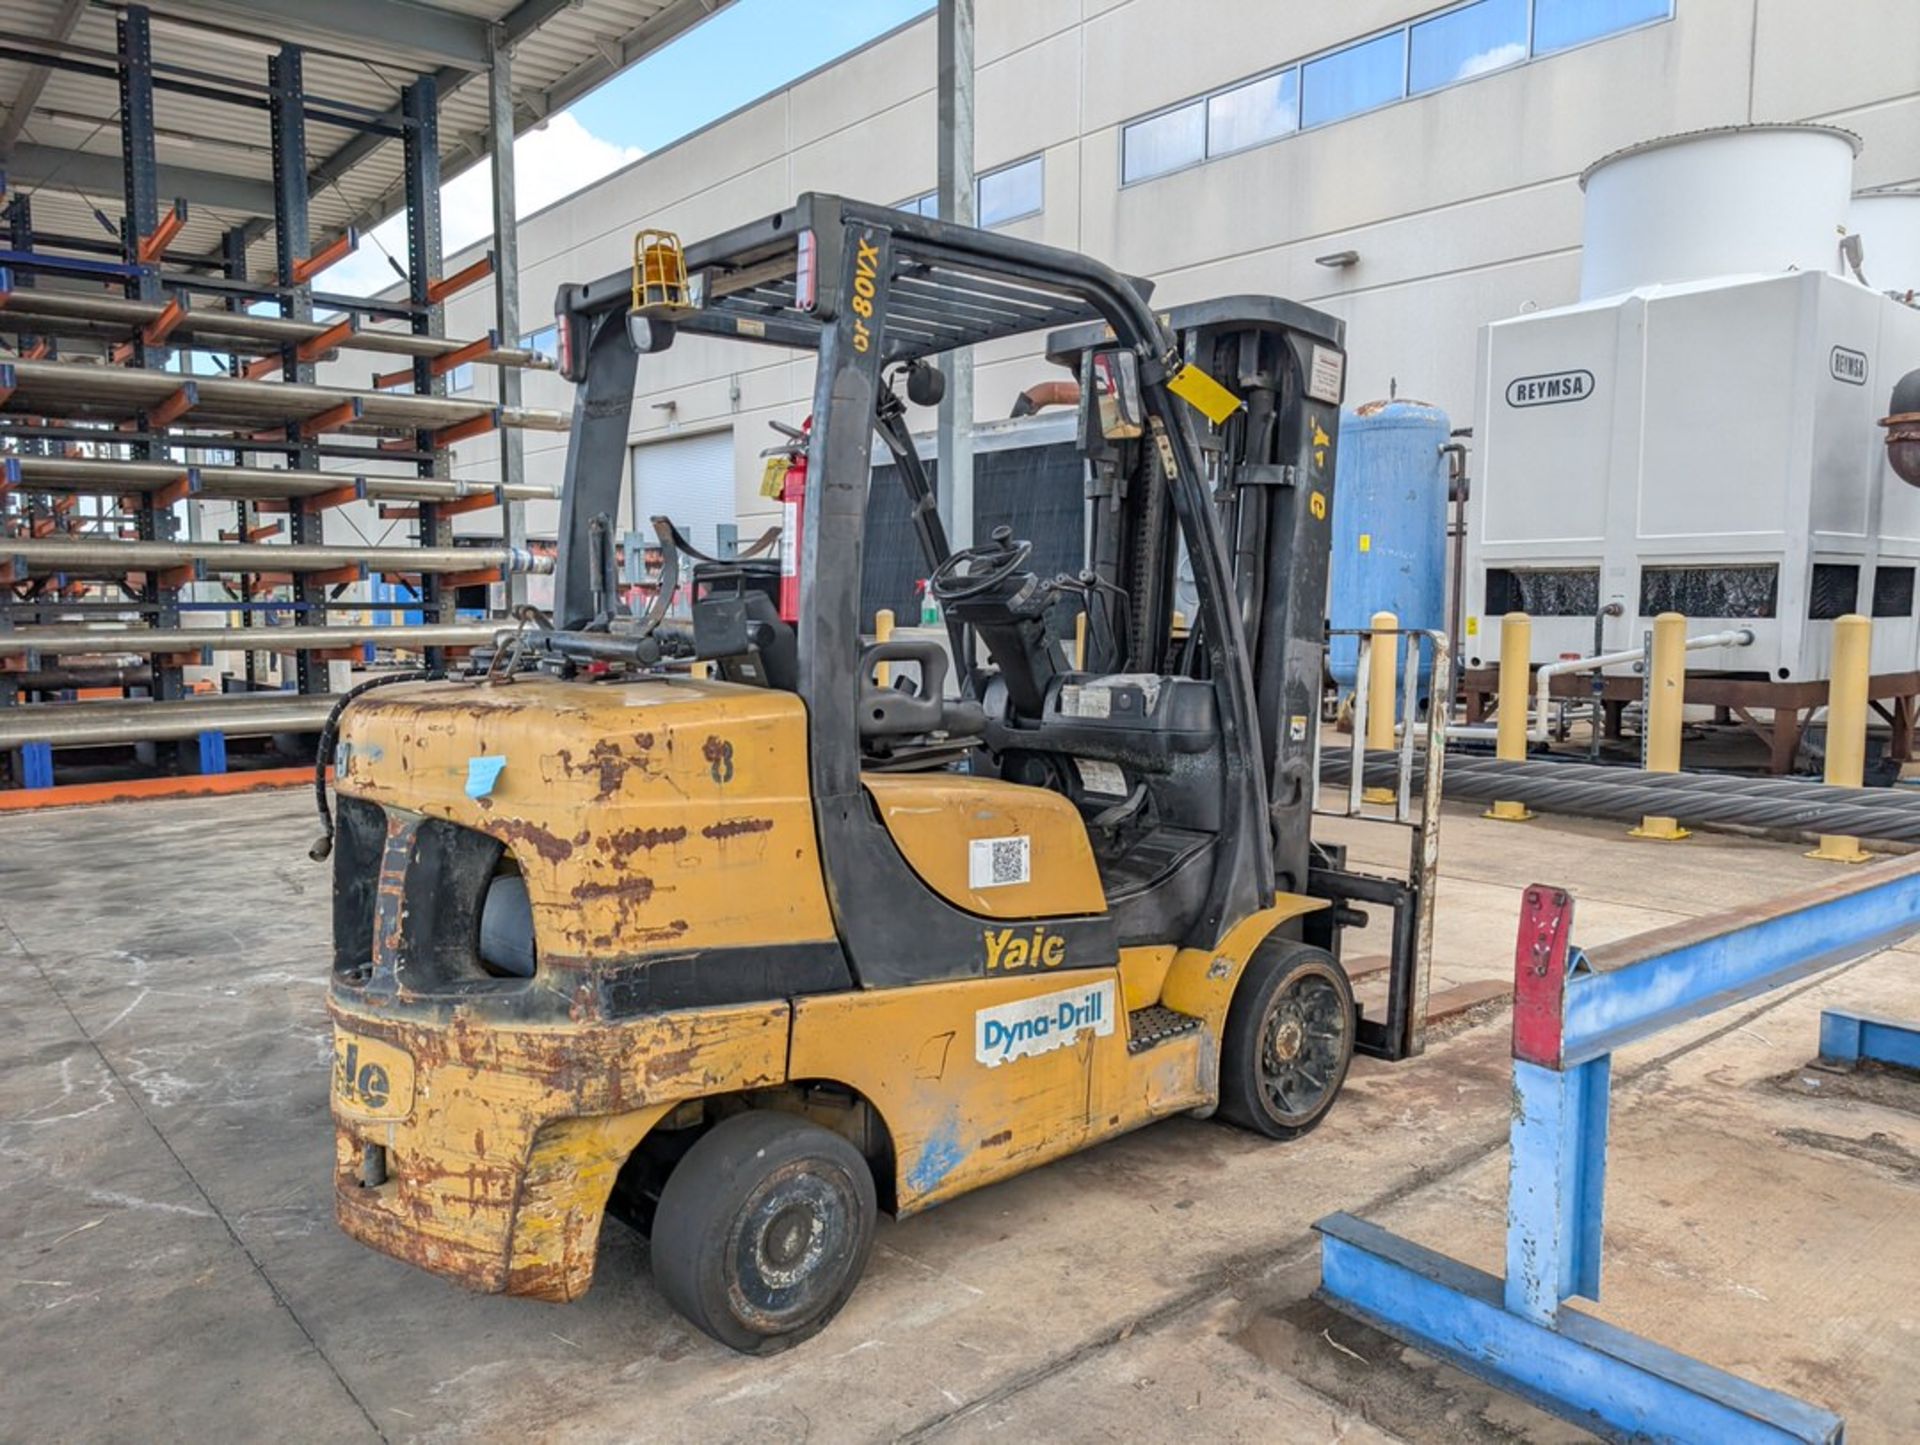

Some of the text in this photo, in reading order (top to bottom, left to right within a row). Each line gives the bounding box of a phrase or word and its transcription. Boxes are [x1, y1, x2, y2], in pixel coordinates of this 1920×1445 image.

[1835, 353, 1864, 378] REYMSA
[1517, 376, 1583, 401] REYMSA
[984, 991, 1102, 1055] Dyna-Drill
